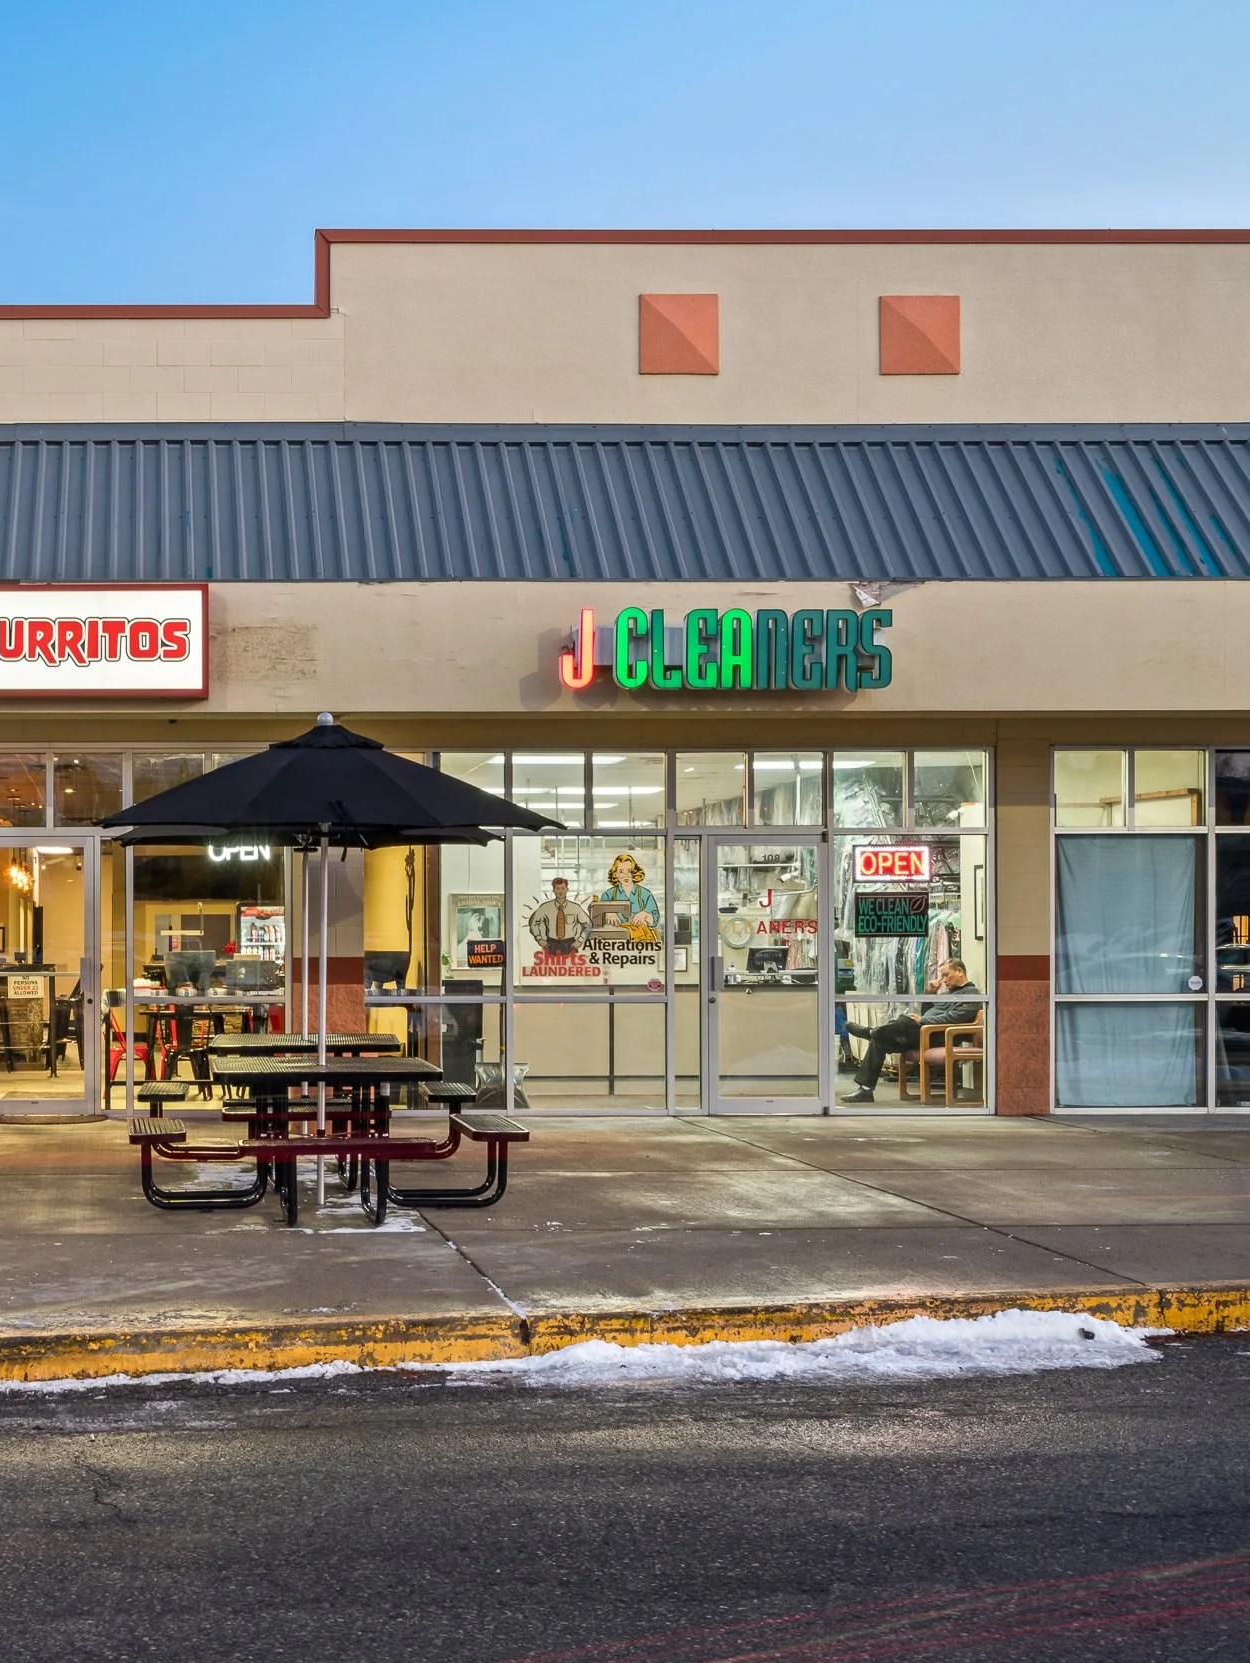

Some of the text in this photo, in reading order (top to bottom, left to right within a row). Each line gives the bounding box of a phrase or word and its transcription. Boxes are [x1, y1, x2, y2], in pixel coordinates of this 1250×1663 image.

[559, 607, 893, 692] J CLEANERS
[860, 851, 926, 875] OPEN
[759, 888, 772, 908] J
[858, 898, 909, 915] WE CLEAN
[858, 915, 928, 932] ECO-FRIENDLY
[474, 944, 497, 953] HELP
[582, 937, 662, 952] Alterations
[468, 954, 504, 964] WANTED
[533, 949, 587, 966] Shirts
[589, 951, 656, 968] & Repairs
[522, 966, 601, 977] LAUNDERED
